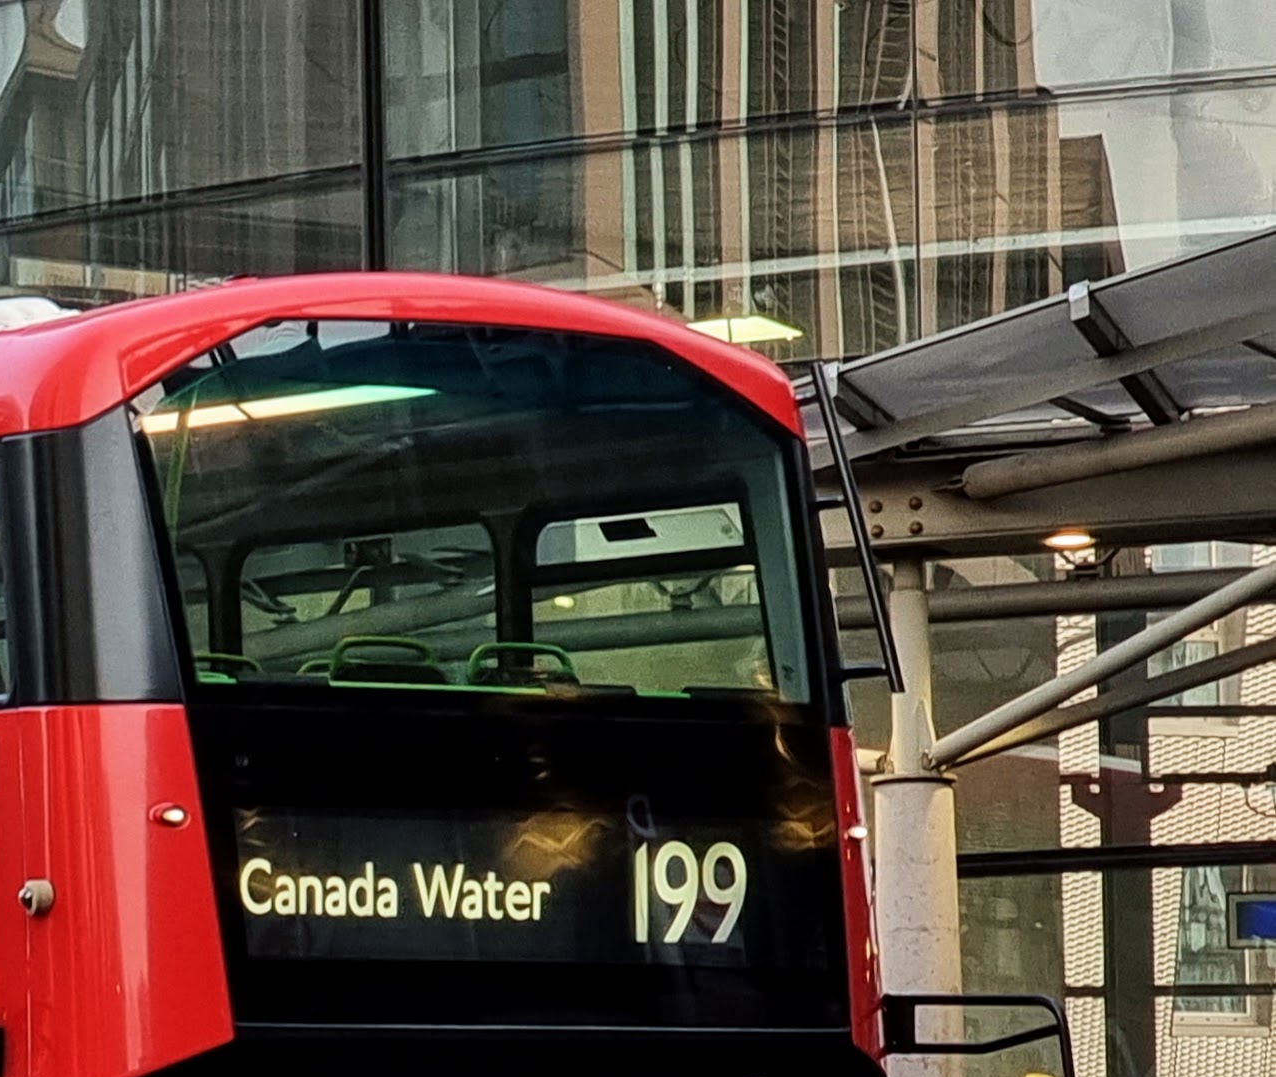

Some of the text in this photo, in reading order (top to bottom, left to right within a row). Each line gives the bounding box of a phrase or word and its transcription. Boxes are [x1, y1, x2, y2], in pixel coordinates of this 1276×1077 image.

[239, 858, 551, 921] Canada Water
[633, 841, 748, 944] 199
